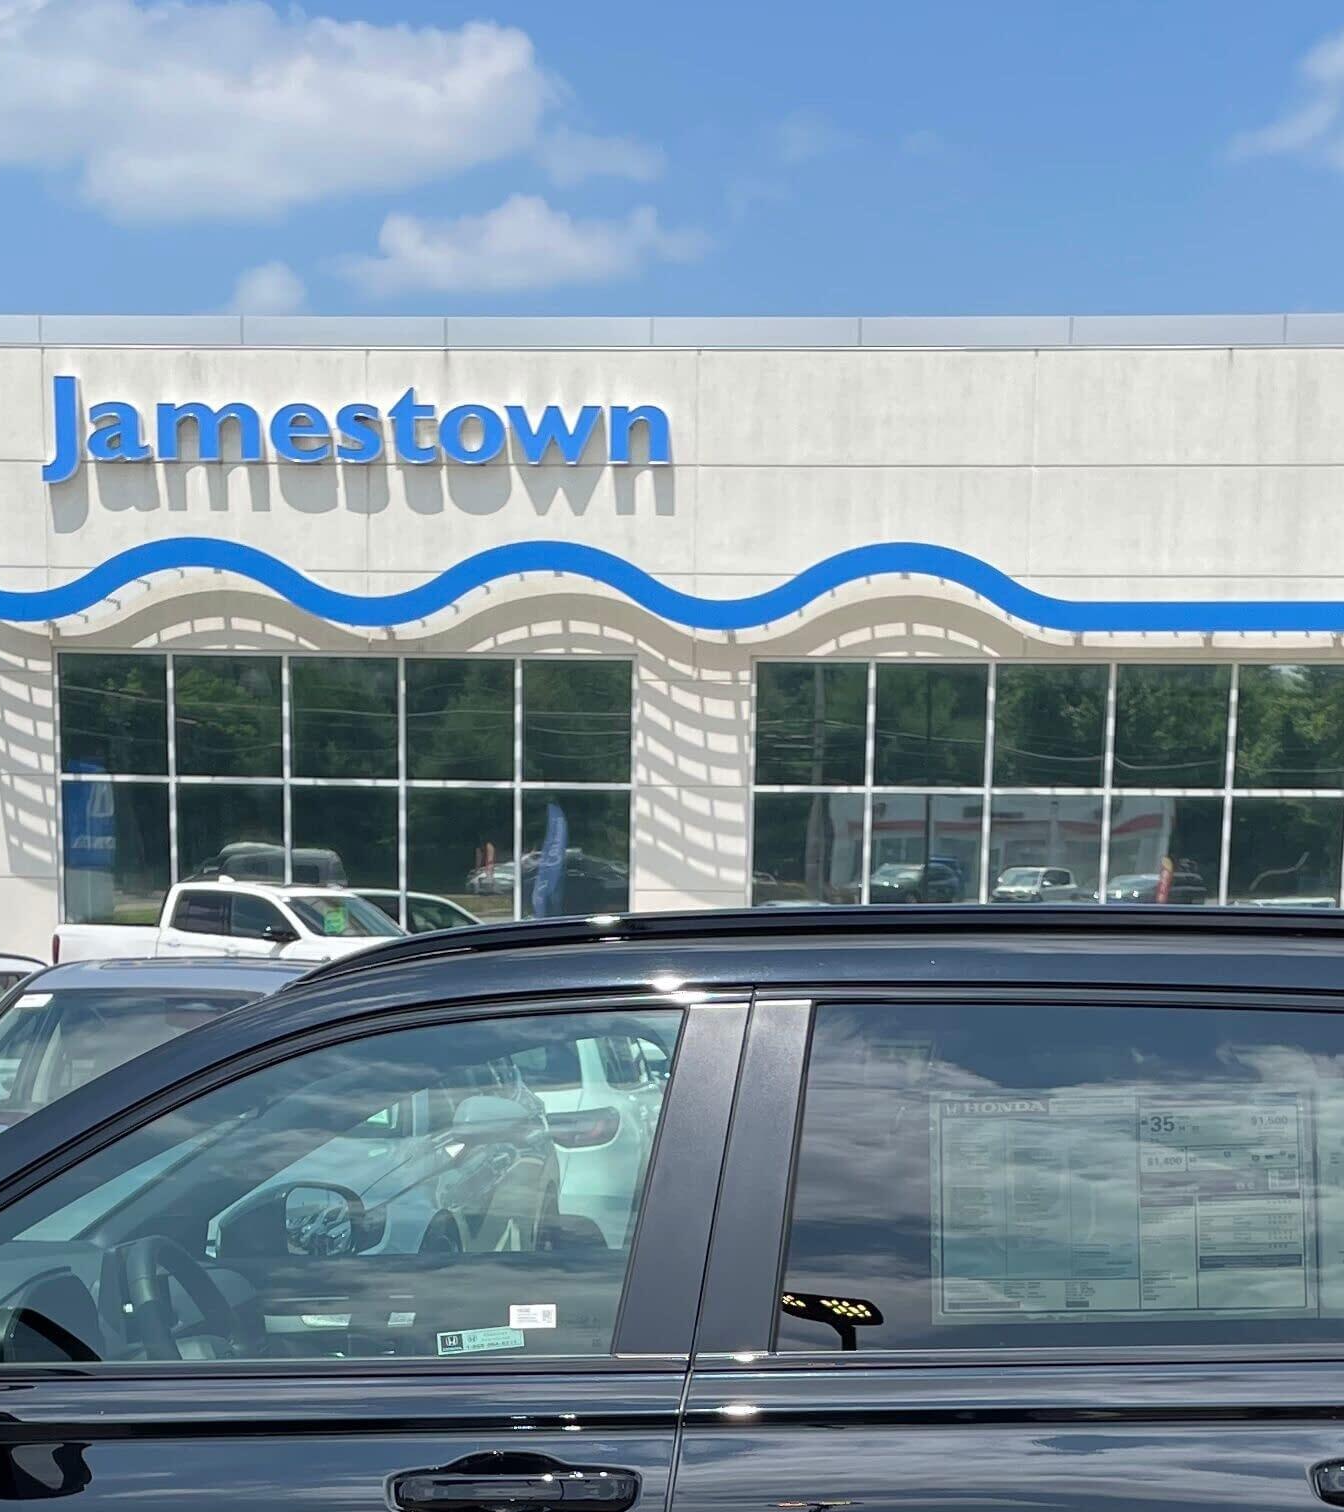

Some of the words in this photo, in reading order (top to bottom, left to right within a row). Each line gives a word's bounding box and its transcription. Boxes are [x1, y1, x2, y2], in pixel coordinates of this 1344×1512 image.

[42, 375, 671, 484] Jamestown
[963, 1100, 1047, 1113] HONDA
[1151, 1116, 1174, 1132] 35
